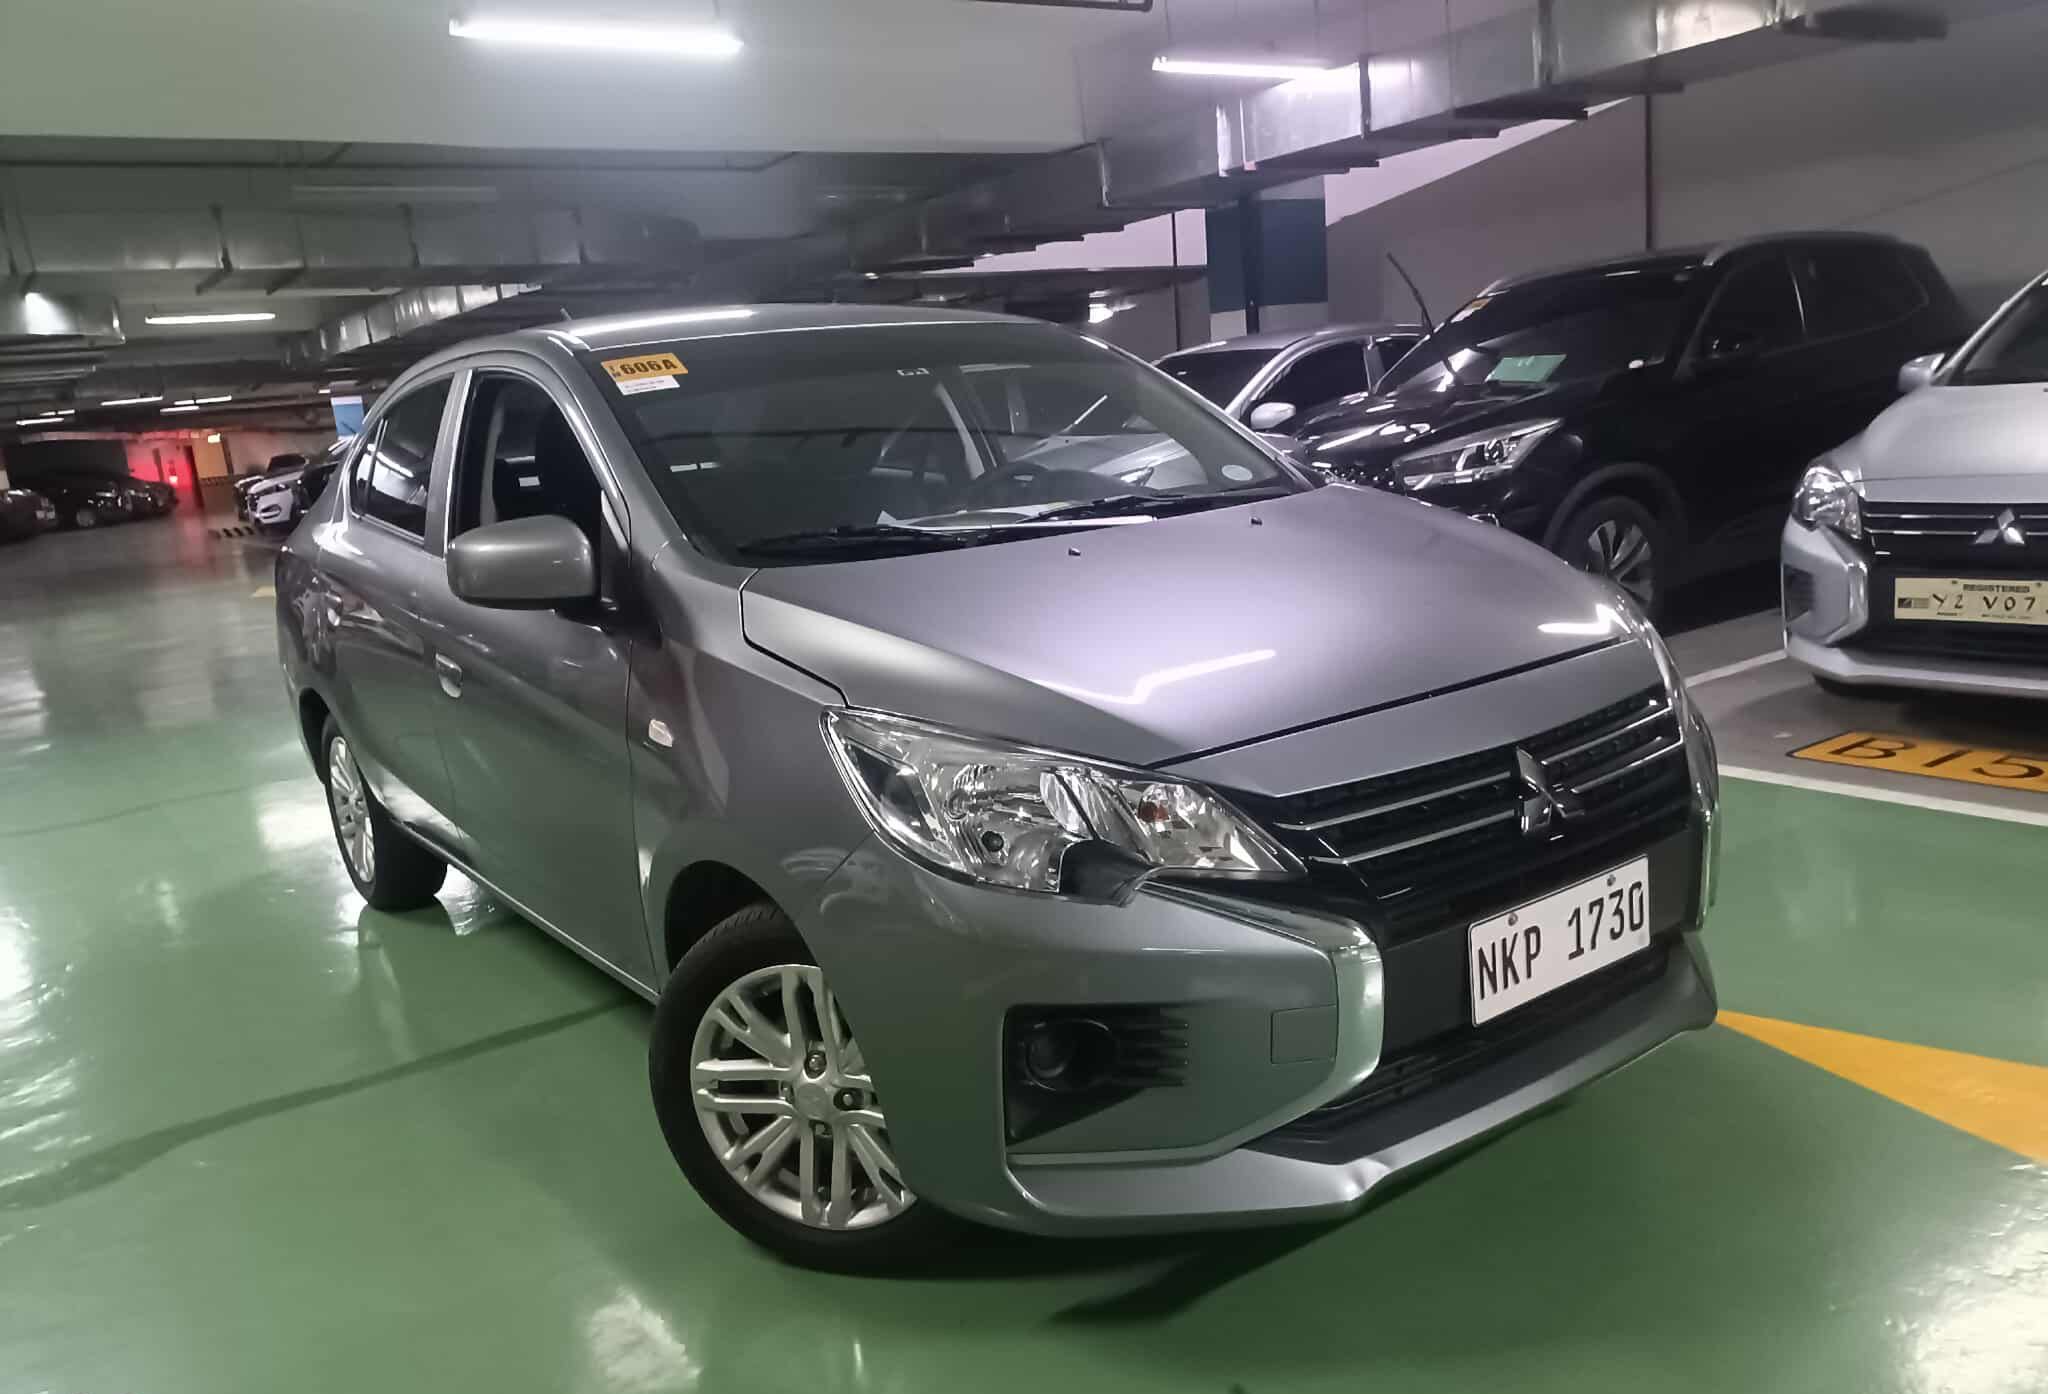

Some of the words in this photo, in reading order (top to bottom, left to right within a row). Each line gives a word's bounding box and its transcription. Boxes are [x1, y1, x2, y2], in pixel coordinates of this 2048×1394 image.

[619, 359, 678, 375] 606A
[1962, 584, 2030, 593] REGISTERED
[1982, 595, 2048, 612] V07
[1477, 925, 1542, 1001] NKP
[1567, 880, 1645, 961] 1730
